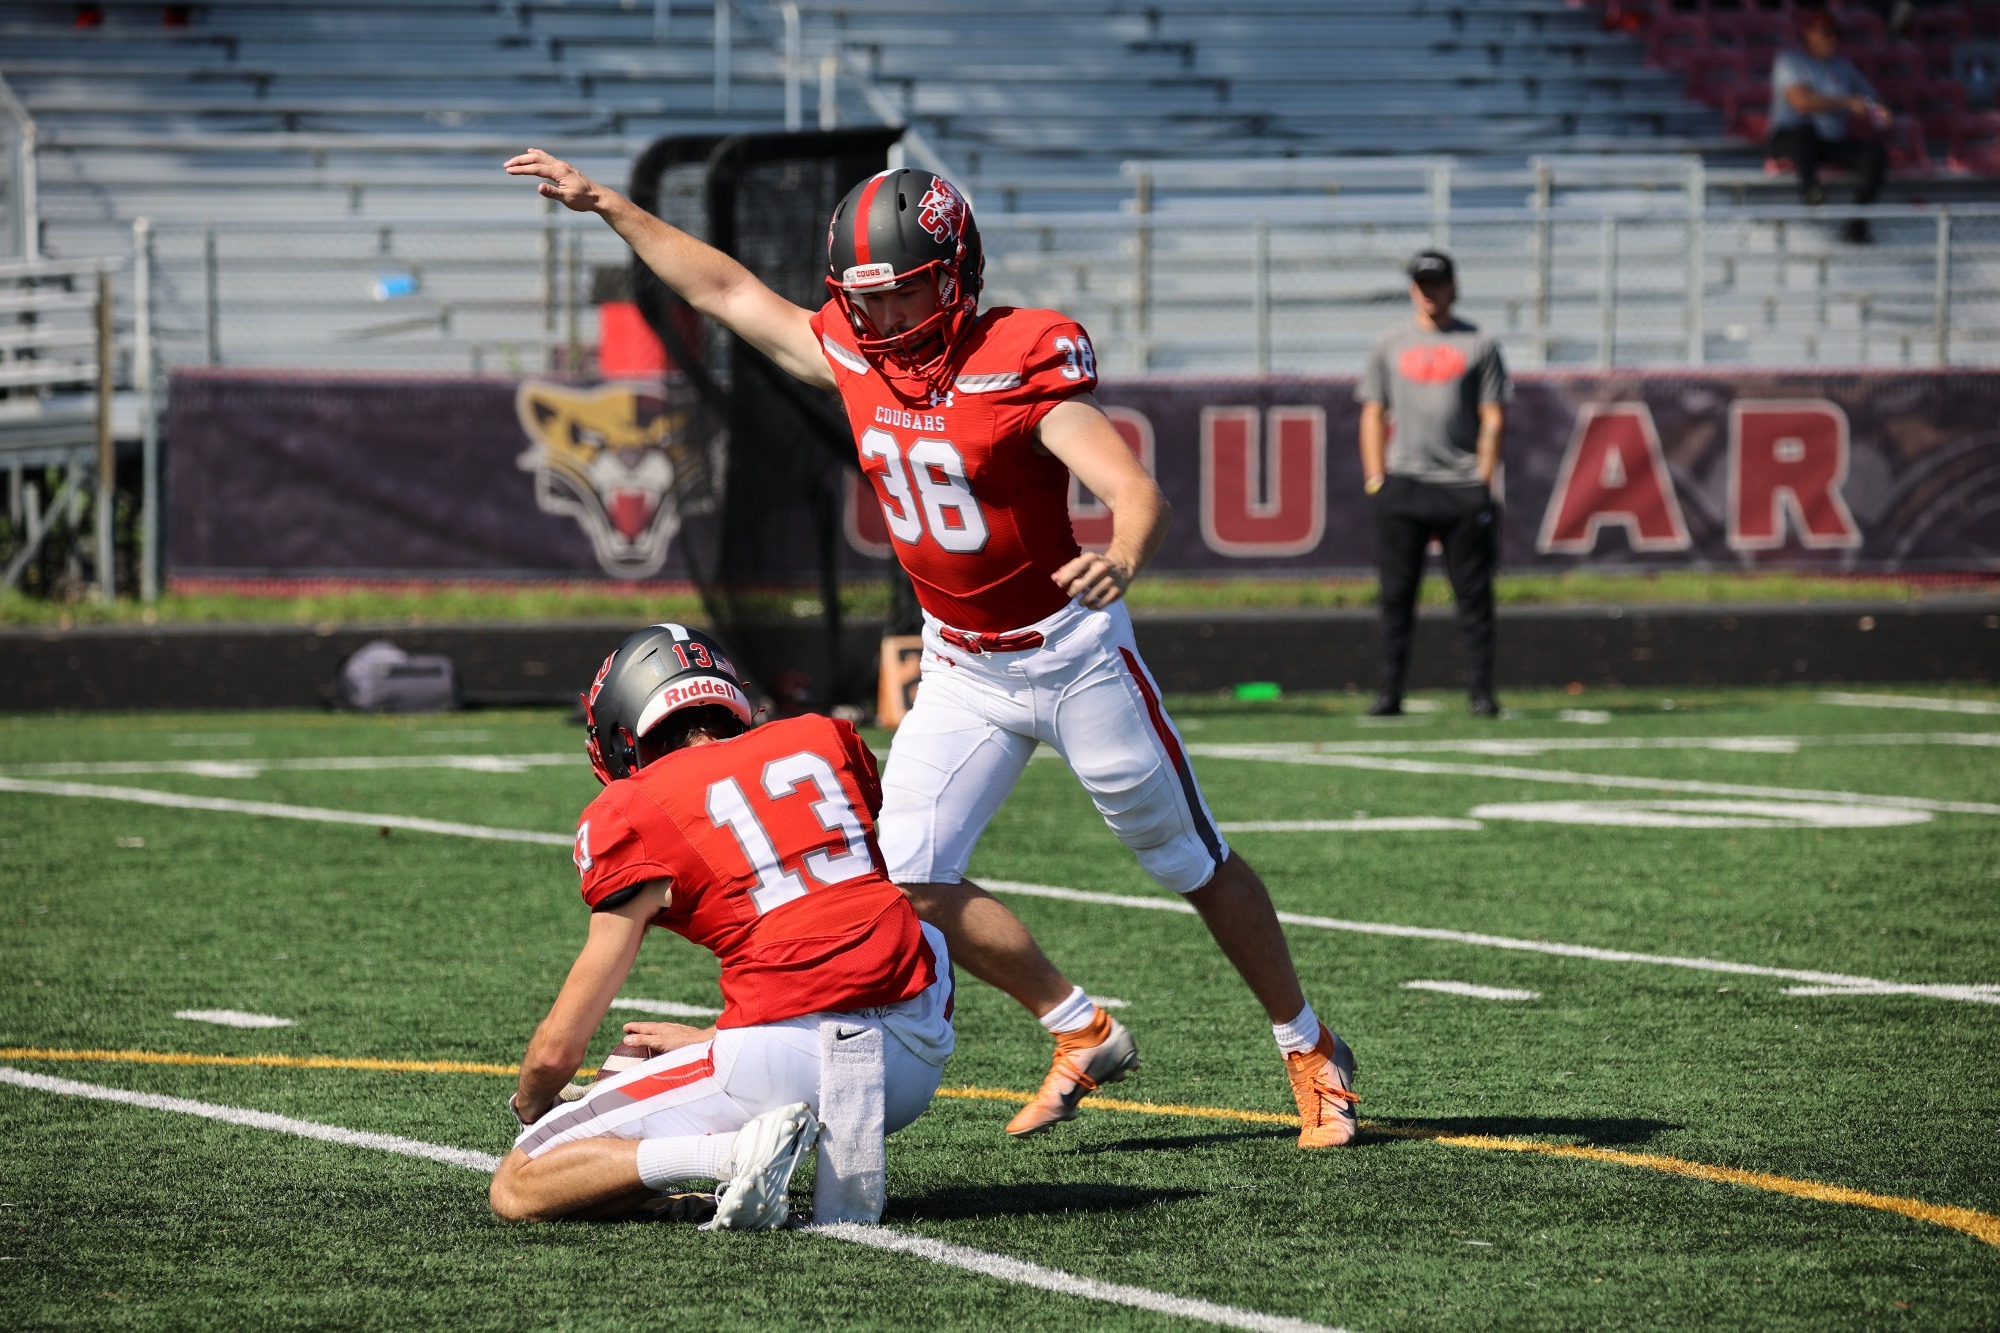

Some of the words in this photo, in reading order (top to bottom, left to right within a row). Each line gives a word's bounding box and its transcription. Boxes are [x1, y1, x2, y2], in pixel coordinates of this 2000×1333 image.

[856, 269, 880, 278] COUGS
[1053, 335, 1096, 380] 38
[874, 405, 946, 432] COUGARS
[860, 425, 990, 554] 38
[671, 642, 713, 669] 13
[663, 680, 737, 707] Riddell
[705, 751, 875, 917] 13
